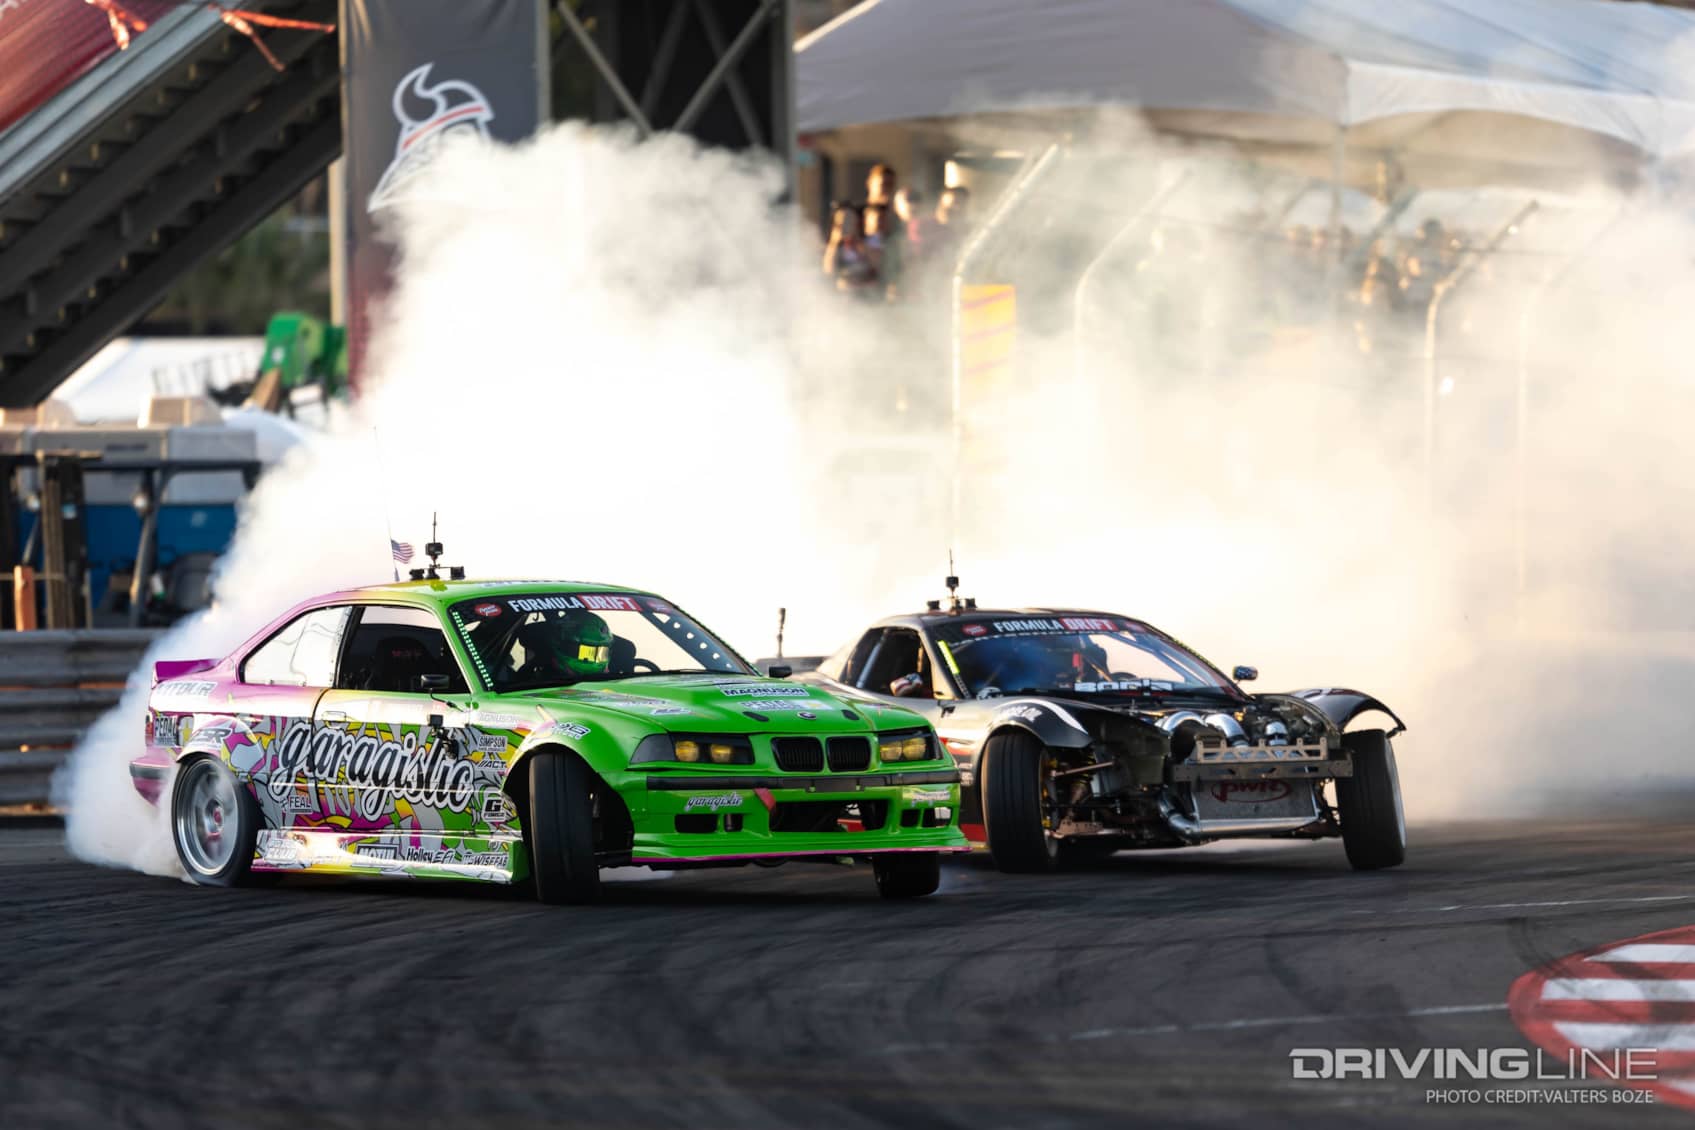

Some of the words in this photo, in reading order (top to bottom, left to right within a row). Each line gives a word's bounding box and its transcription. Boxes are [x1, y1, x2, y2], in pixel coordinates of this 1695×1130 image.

[507, 596, 586, 612] FORMULA
[586, 596, 637, 611] DRIFT
[993, 619, 1065, 632] FORMULA
[1065, 618, 1114, 631] DRIFT
[479, 736, 505, 747] SIMPSON
[289, 796, 311, 808] FEAL
[406, 847, 433, 863] Holley
